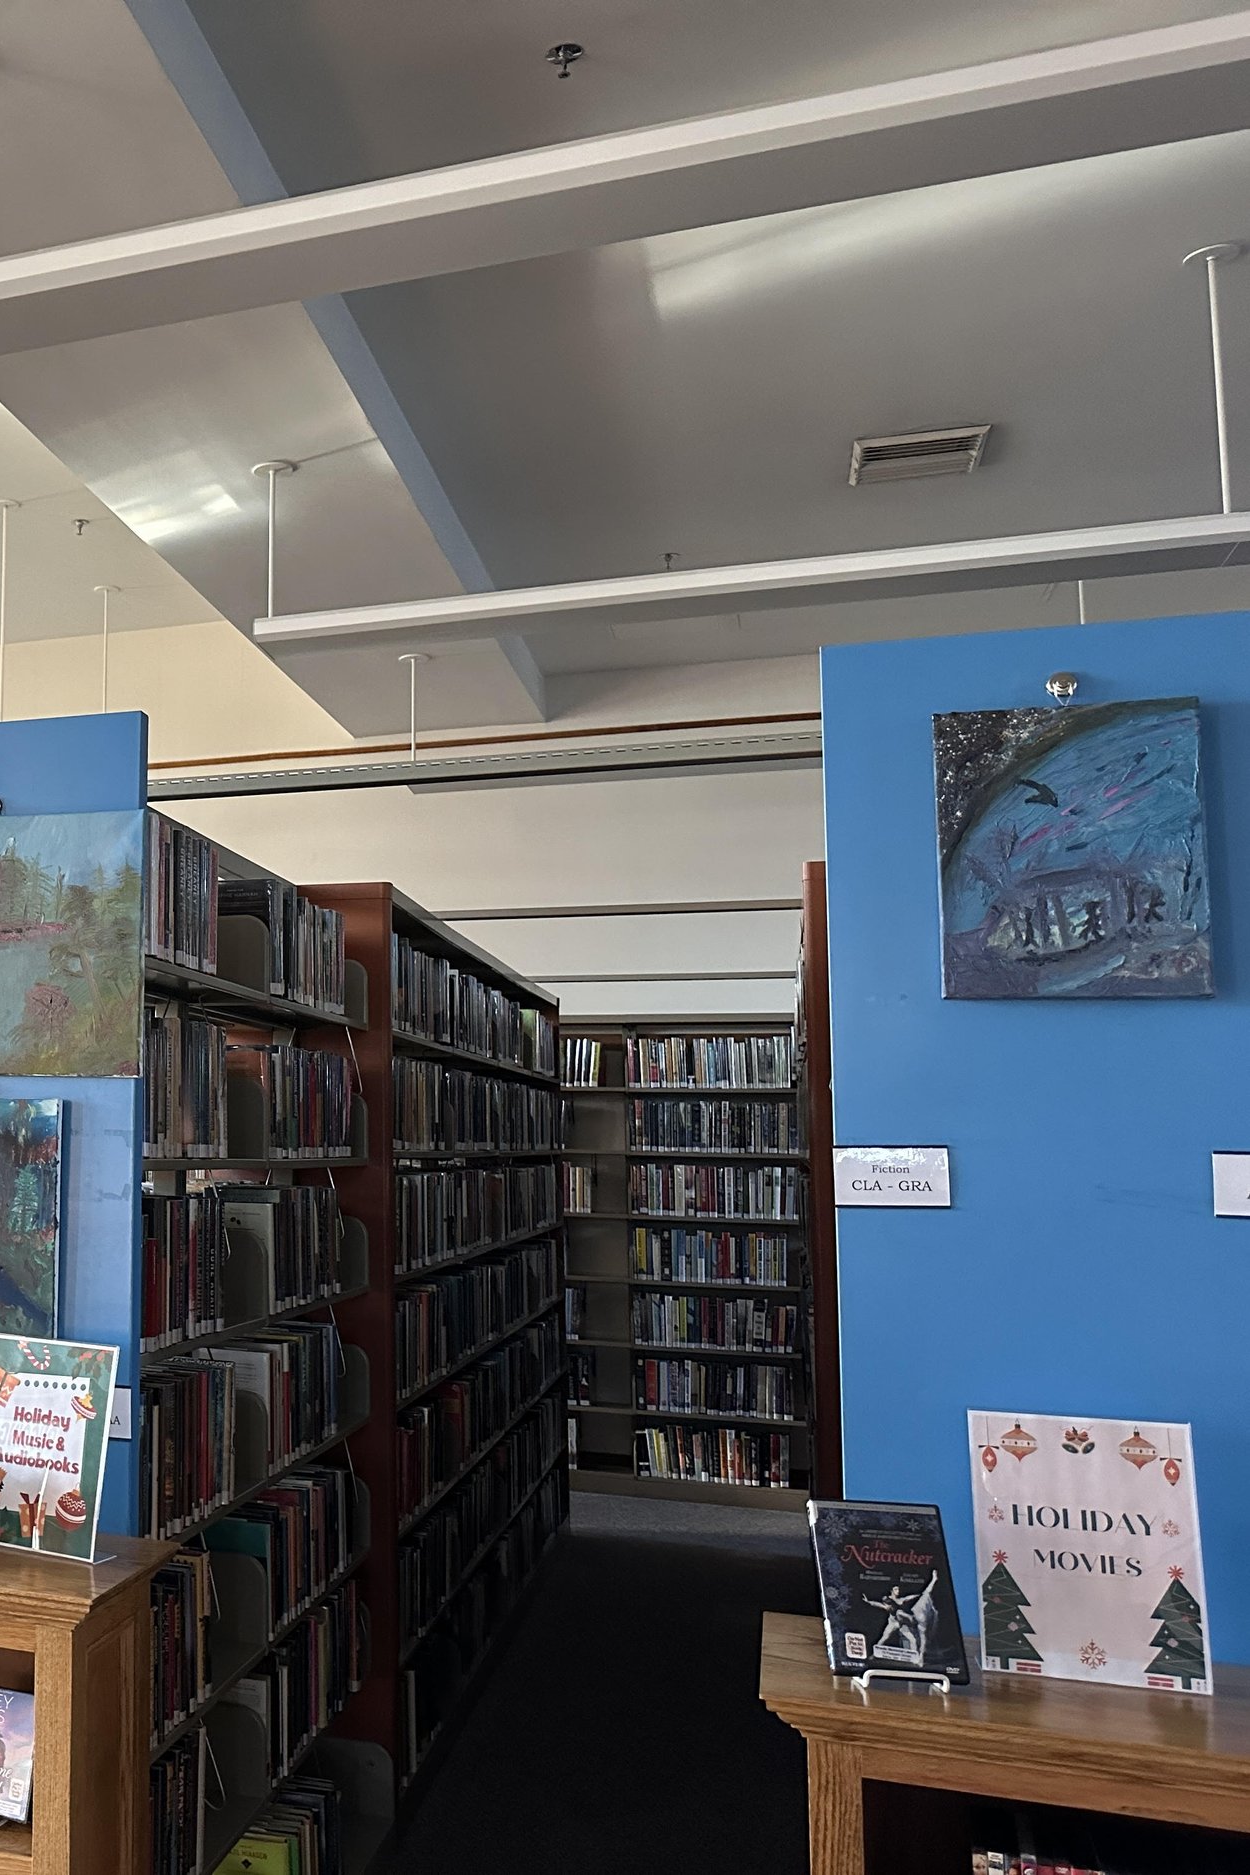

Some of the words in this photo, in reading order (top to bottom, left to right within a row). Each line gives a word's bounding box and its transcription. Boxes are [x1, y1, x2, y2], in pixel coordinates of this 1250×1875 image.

[871, 1164, 911, 1174] Fiction
[851, 1180, 883, 1191] CLA
[898, 1180, 933, 1192] GRA
[13, 1406, 71, 1432] Holiday
[12, 1429, 54, 1450] Music
[55, 1436, 65, 1452] &
[1012, 1503, 1158, 1536] HOLIDAY
[840, 1544, 934, 1569] Nutcracker
[1033, 1549, 1142, 1577] MOVIES
